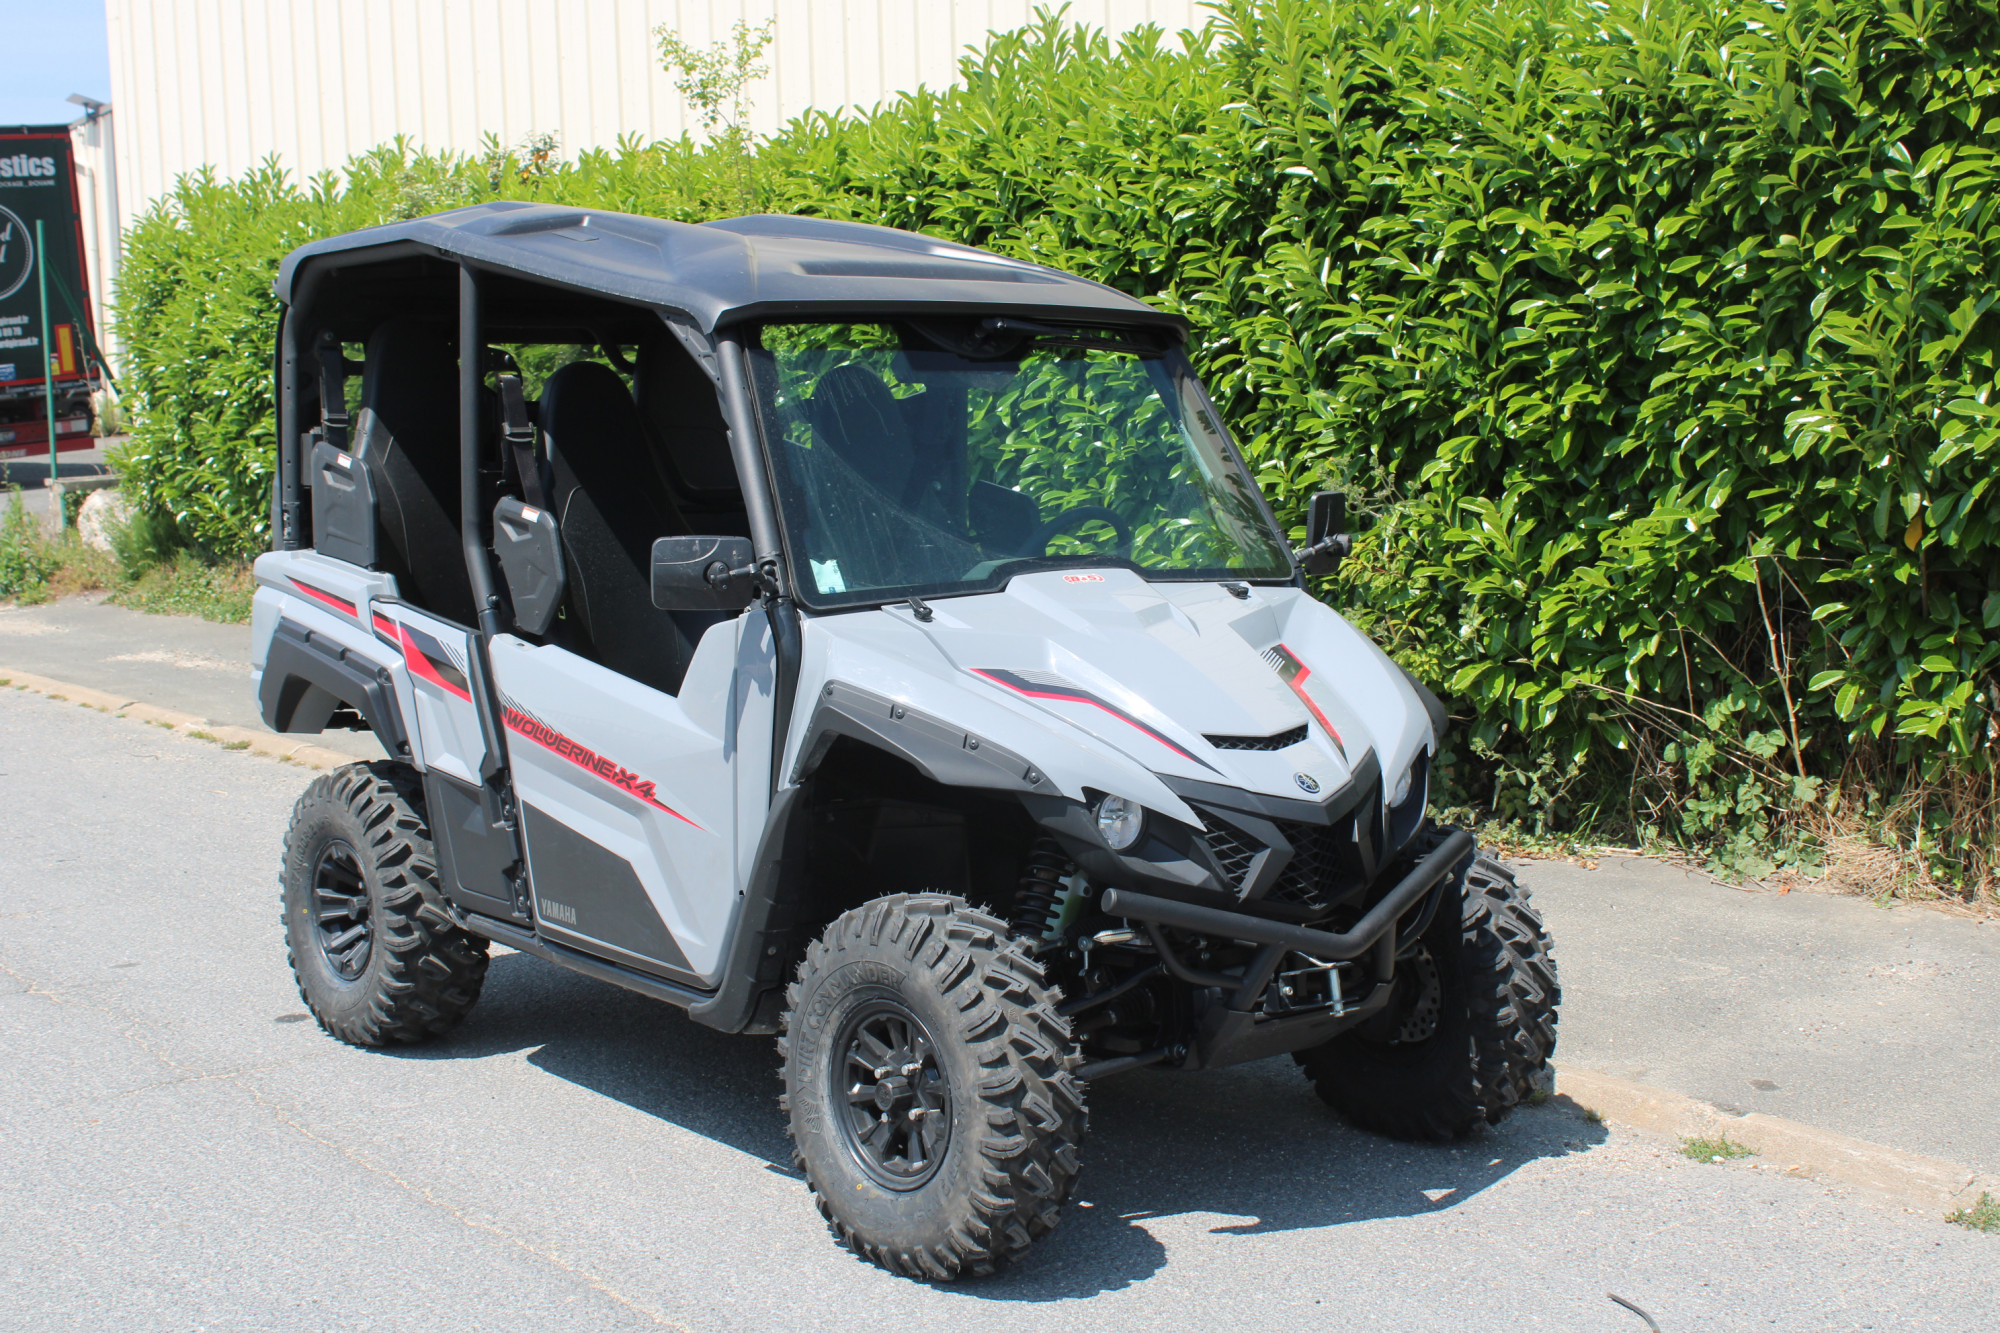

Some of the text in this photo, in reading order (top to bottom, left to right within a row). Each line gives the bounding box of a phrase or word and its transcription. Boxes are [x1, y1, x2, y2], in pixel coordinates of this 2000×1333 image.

[506, 708, 654, 799] WOLVERINE X4
[541, 898, 577, 925] YAMAHA
[806, 963, 902, 1030] COMMANDER
